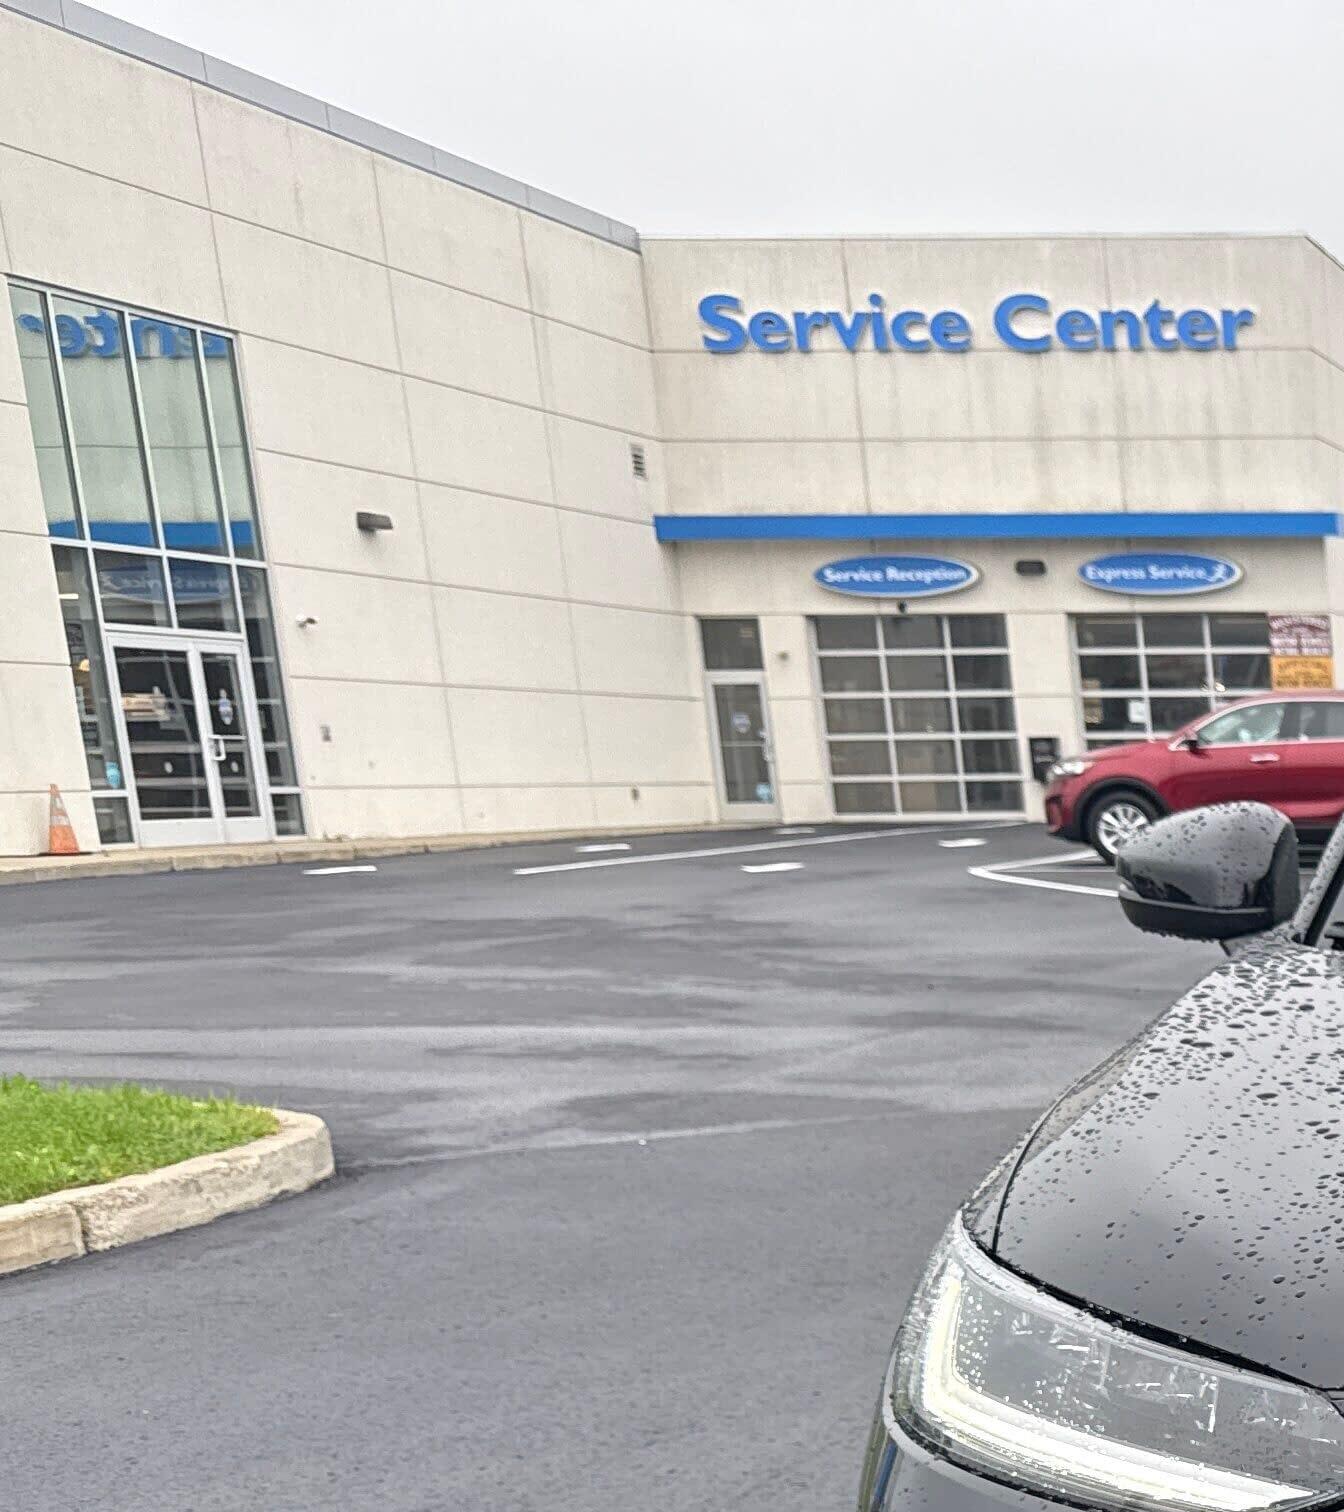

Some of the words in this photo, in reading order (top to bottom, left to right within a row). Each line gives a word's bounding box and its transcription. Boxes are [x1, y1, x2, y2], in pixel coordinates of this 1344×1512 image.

[698, 293, 974, 353] Service
[993, 293, 1257, 353] Center
[823, 567, 883, 582] Service
[886, 566, 967, 584] Reception
[1085, 564, 1146, 583] Express
[1149, 564, 1206, 580] Service
